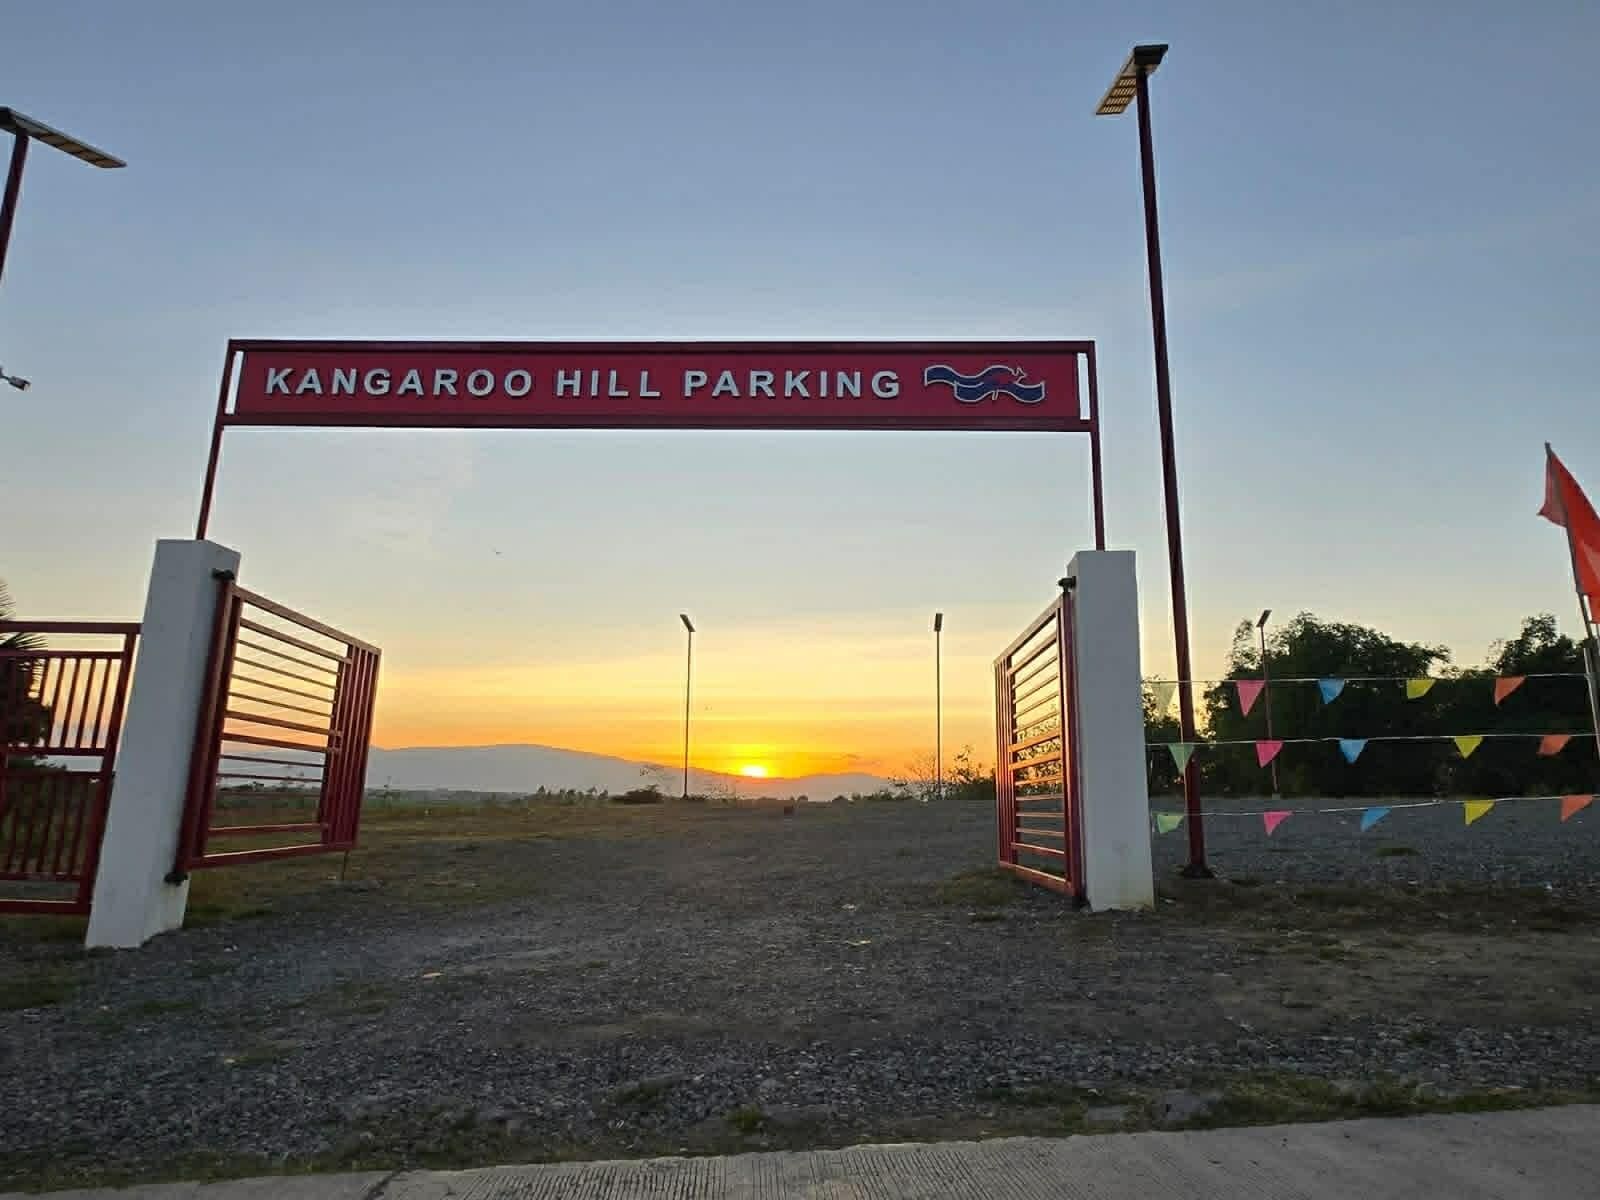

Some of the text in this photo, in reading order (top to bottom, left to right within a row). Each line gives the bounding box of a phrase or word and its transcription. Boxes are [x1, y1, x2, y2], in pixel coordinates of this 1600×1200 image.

[265, 367, 901, 399] KANGAROO HILL PARKING
